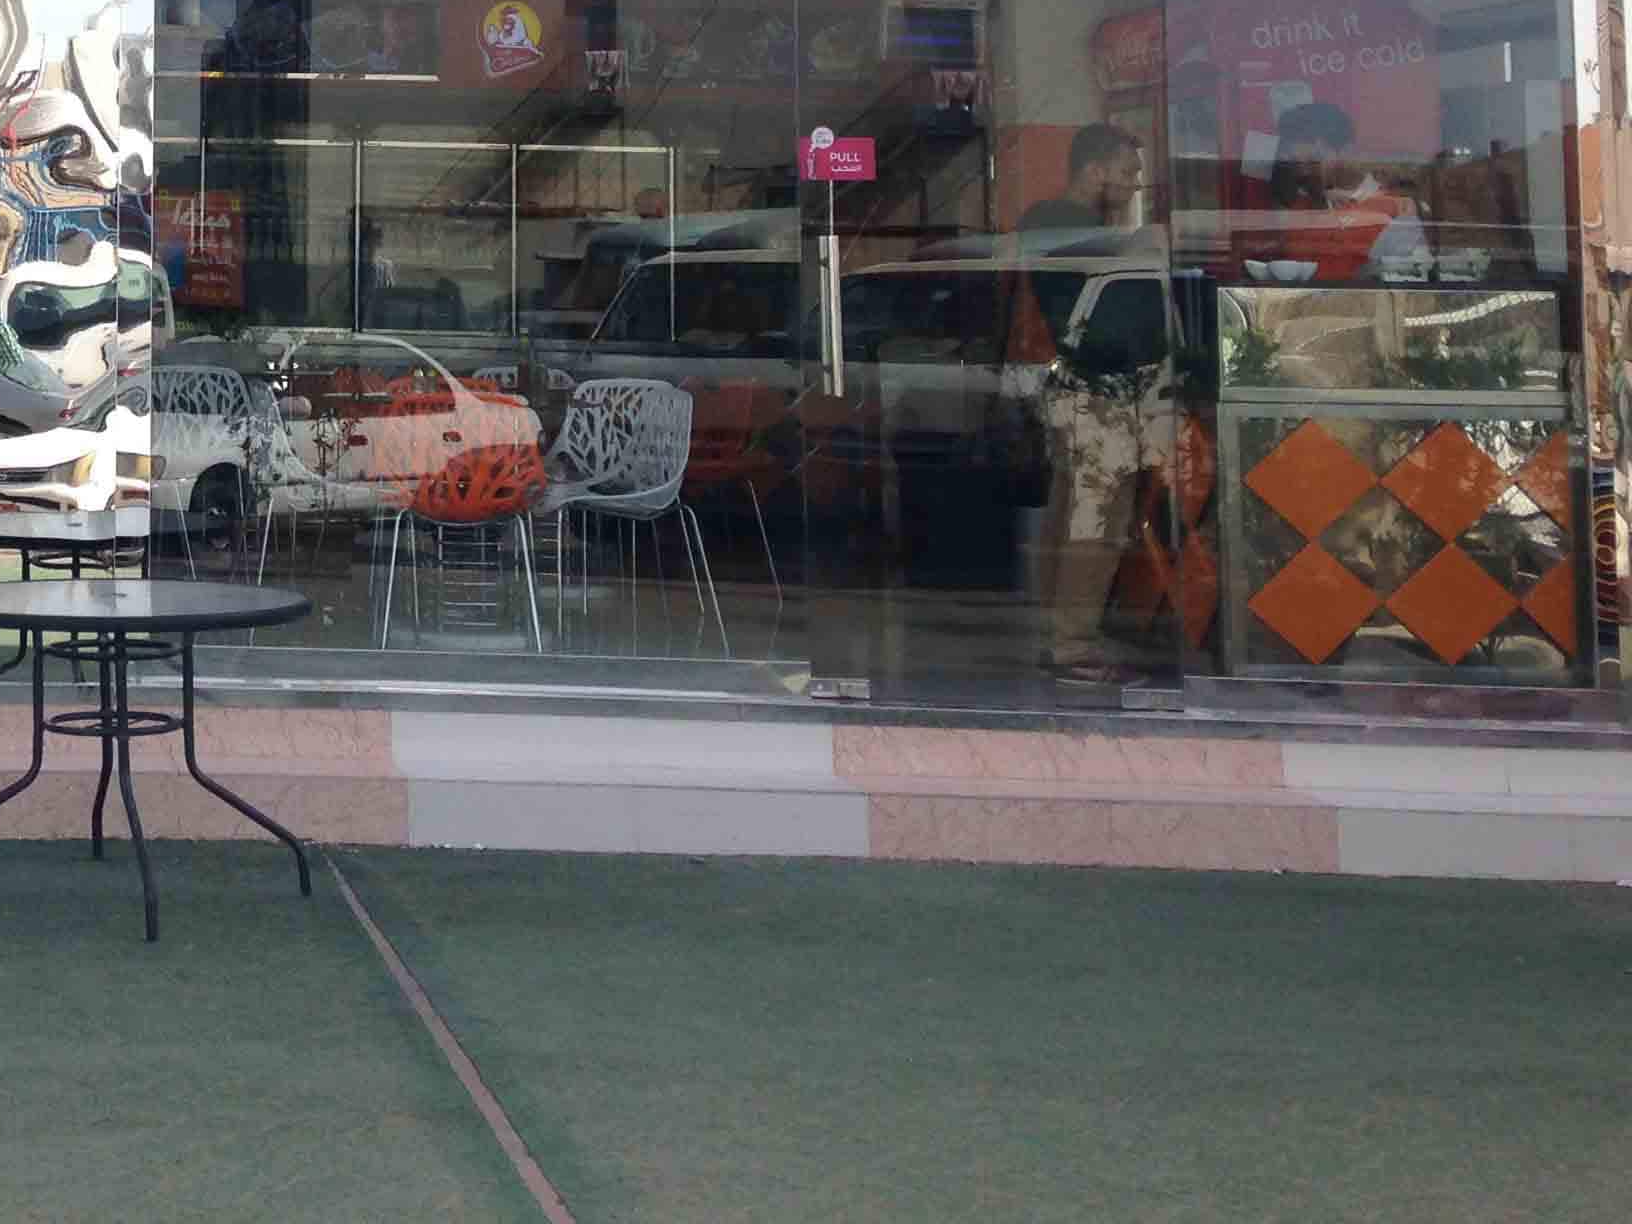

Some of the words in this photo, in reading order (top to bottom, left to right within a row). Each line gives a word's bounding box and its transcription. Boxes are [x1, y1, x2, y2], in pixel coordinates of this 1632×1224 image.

[1250, 7, 1335, 49] drink
[1343, 9, 1364, 38] it
[1297, 47, 1346, 75] ice
[1359, 33, 1425, 71] cold
[830, 151, 862, 163] PULL
